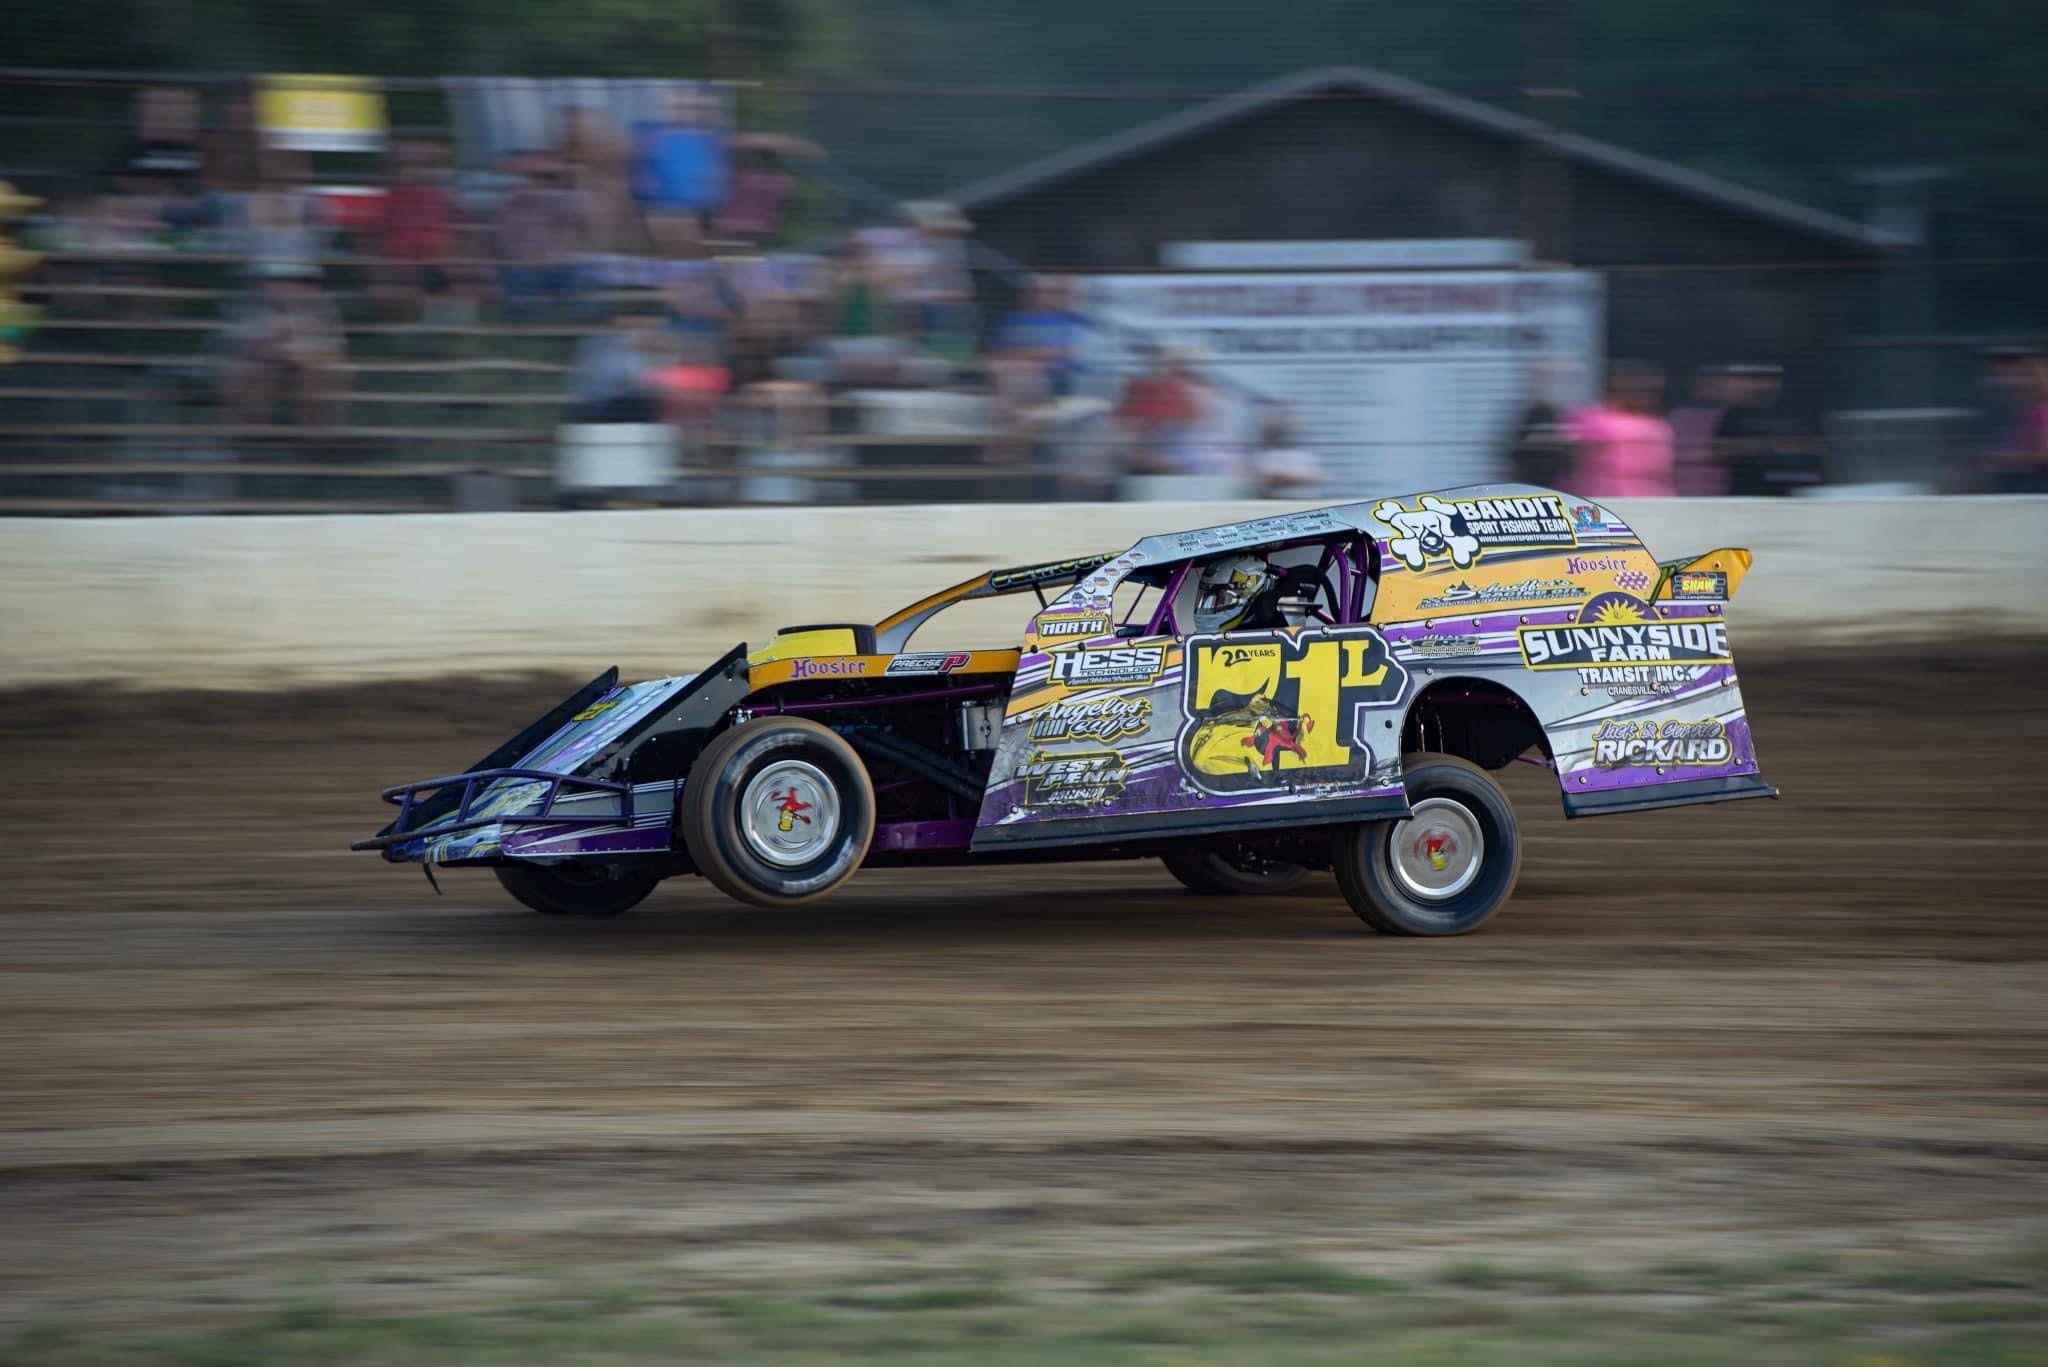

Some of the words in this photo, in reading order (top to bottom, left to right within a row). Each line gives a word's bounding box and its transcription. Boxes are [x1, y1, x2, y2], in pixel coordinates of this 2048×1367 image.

[1455, 497, 1561, 520] BANDIT
[1466, 520, 1500, 535] SPORT
[1501, 519, 1540, 534] FISHING
[1540, 518, 1571, 532] TEAM
[1566, 556, 1628, 575] Hoosier
[1681, 576, 1716, 593] SHAW
[1042, 620, 1104, 636] NORTH
[1523, 623, 1731, 665] SUNNYSIDE
[1591, 645, 1671, 662] FARM
[892, 659, 944, 668] PRECISE
[1053, 647, 1163, 680] HESS
[1221, 648, 1252, 668] 20
[1247, 648, 1277, 658] YEARS
[791, 657, 866, 679] Hoosier
[1080, 665, 1157, 677] TECHNOLOGY
[1578, 666, 1650, 684] TRANSIT
[1656, 665, 1692, 682] INC.
[1594, 721, 1638, 740] Jack
[1641, 720, 1658, 739] &
[1596, 739, 1729, 762] RICKARD
[1017, 756, 1115, 777] WEST
[1044, 769, 1127, 788] PENN
